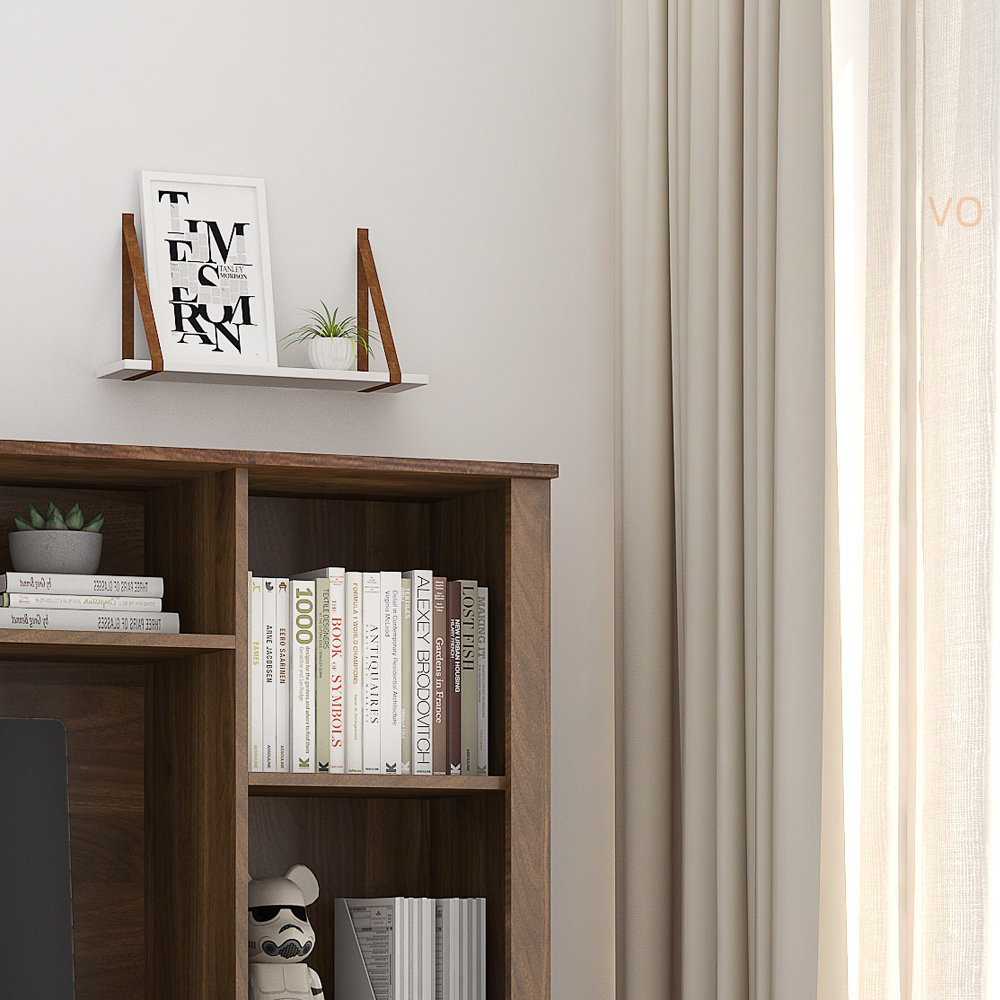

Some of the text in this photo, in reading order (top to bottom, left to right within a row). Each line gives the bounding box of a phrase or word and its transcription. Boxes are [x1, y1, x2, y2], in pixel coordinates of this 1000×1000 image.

[296, 588, 313, 644] 1000
[331, 617, 342, 658] BOOK
[462, 585, 474, 671] LOST FISH
[477, 596, 485, 659] MAKING IT
[369, 624, 379, 724] ANTIQUAIRES
[417, 575, 430, 764] ALEXEY BRODOVITCH
[435, 637, 444, 724] Gardens in France
[331, 674, 342, 747] SYMBOLS
